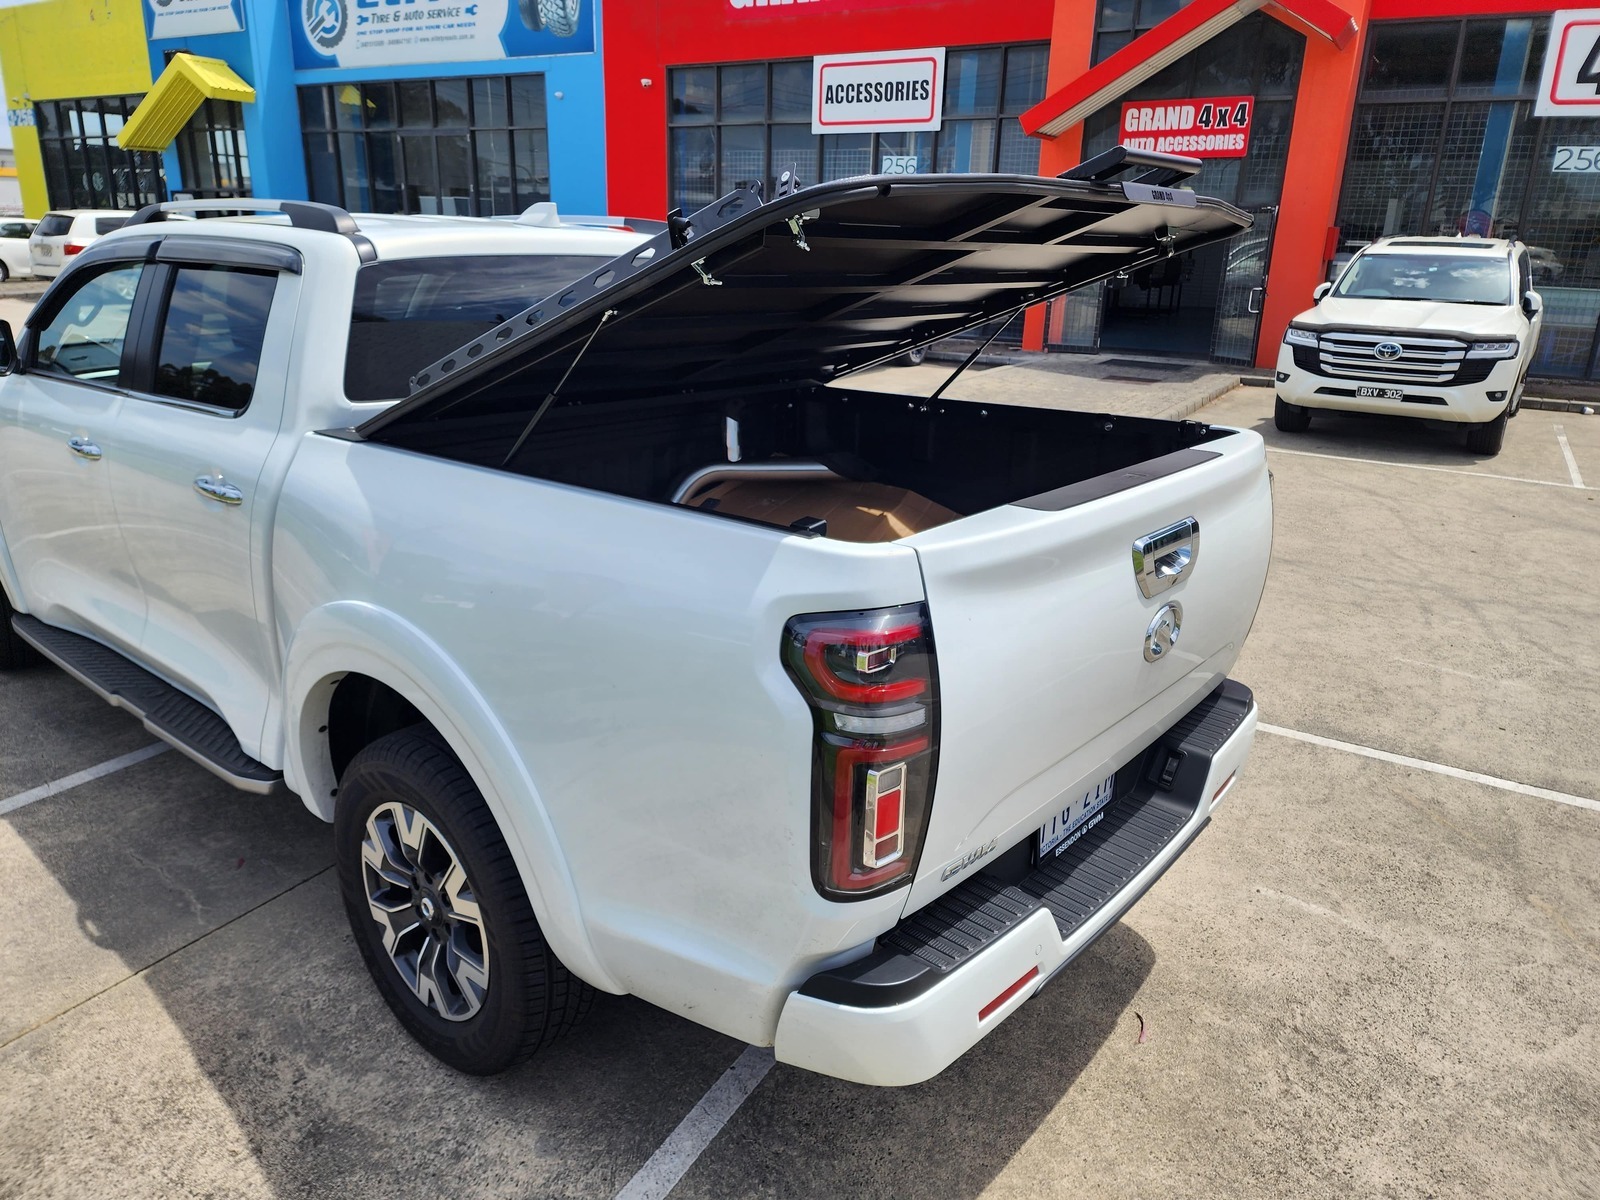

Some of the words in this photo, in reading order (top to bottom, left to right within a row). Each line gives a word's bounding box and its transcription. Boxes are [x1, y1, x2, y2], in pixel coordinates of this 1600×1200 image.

[371, 12, 390, 24] TYRE
[393, 10, 401, 22] &
[403, 10, 424, 21] AUTO
[824, 79, 930, 105] ACCESSORIES
[1125, 106, 1195, 132] GRAND
[1197, 101, 1249, 131] 4x4
[1123, 137, 1155, 151] AUTO
[1156, 134, 1245, 152] ACCESSORIES
[883, 157, 916, 175] 256
[1151, 189, 1165, 201] GRAND
[1063, 825, 1072, 835] THE
[1072, 806, 1096, 828] EDUCATION
[1096, 794, 1109, 809] STATE
[1056, 830, 1081, 857] ESSENDON
[1088, 812, 1104, 830] GWM
